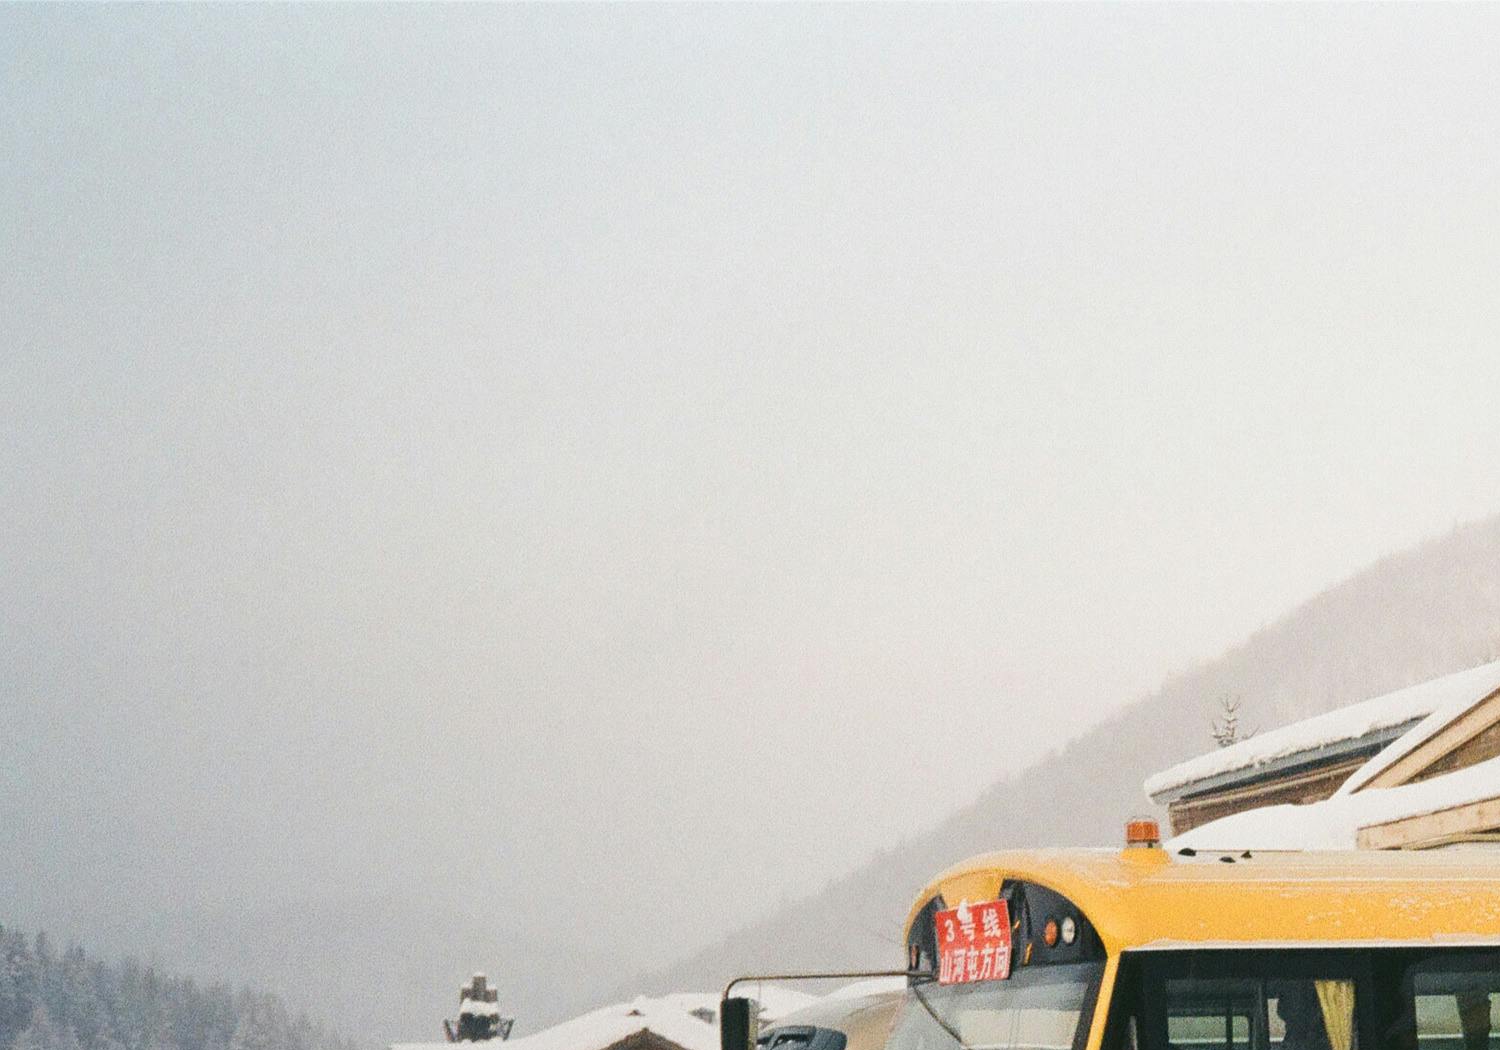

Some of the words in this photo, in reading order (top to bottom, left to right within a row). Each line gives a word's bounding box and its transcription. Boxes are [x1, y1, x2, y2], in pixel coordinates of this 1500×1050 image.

[940, 941, 1009, 983] 山河屯方向
